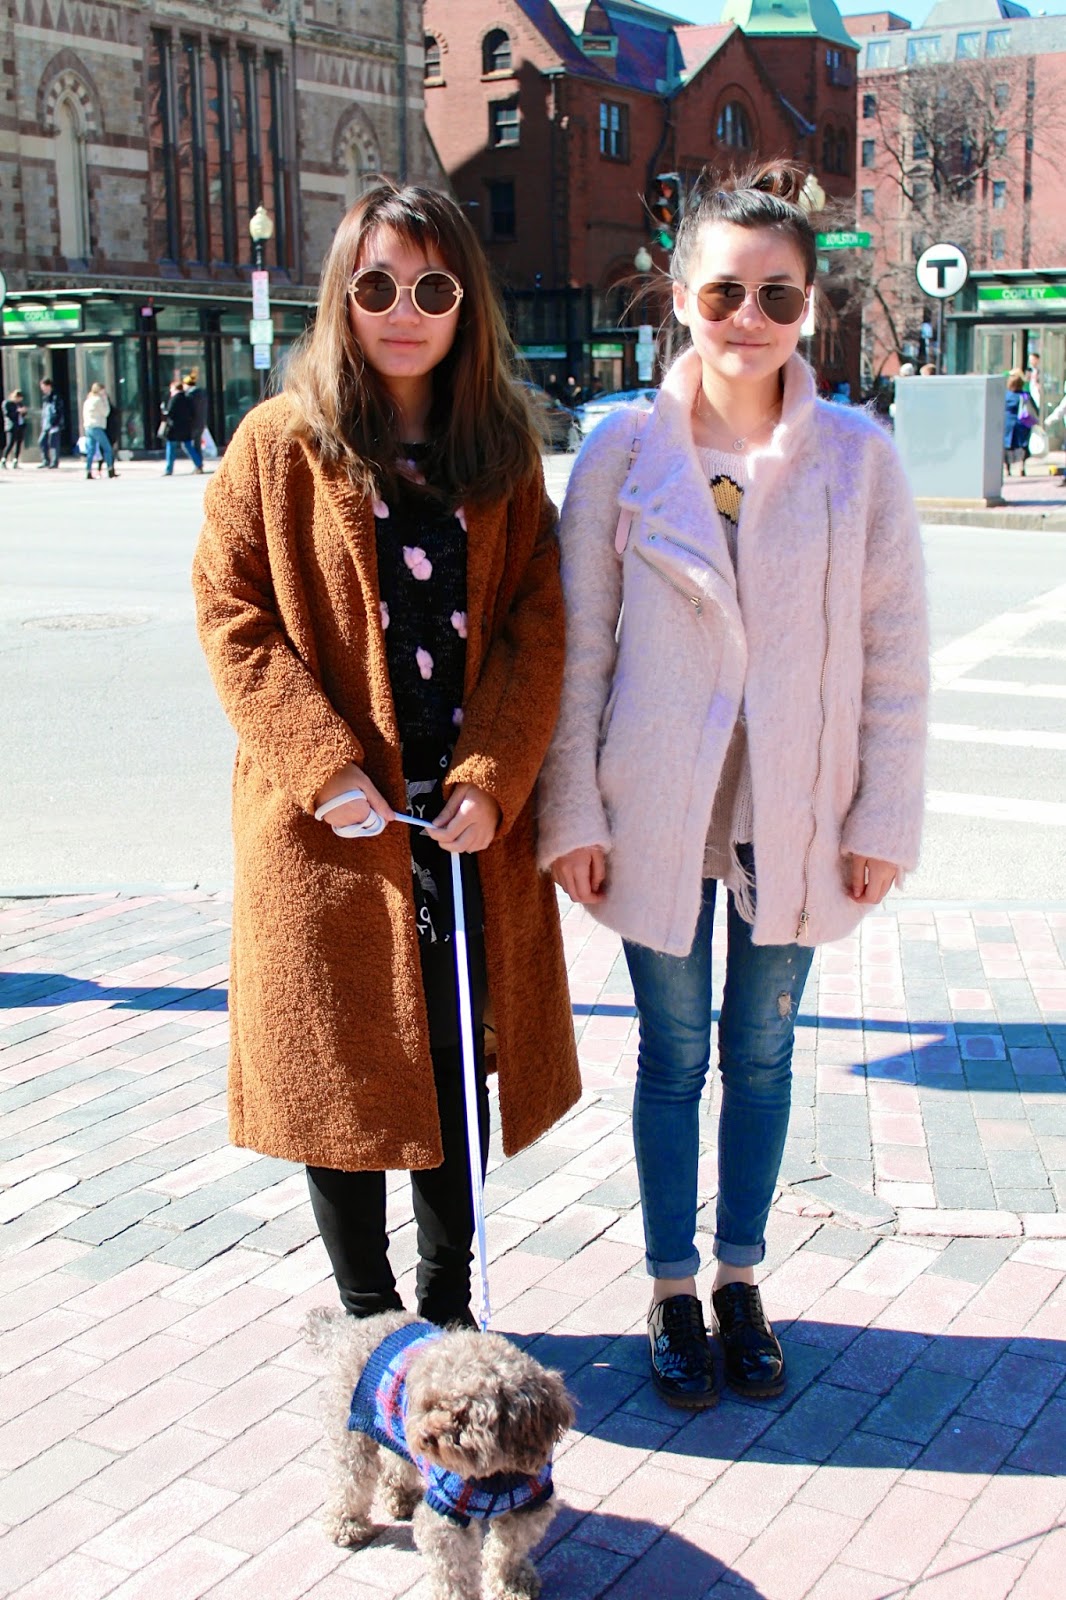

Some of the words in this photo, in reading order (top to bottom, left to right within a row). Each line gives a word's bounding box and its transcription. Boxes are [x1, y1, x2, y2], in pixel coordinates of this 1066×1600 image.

[926, 259, 958, 289] T
[1001, 287, 1046, 299] COPLEY
[24, 310, 55, 321] COPLEY
